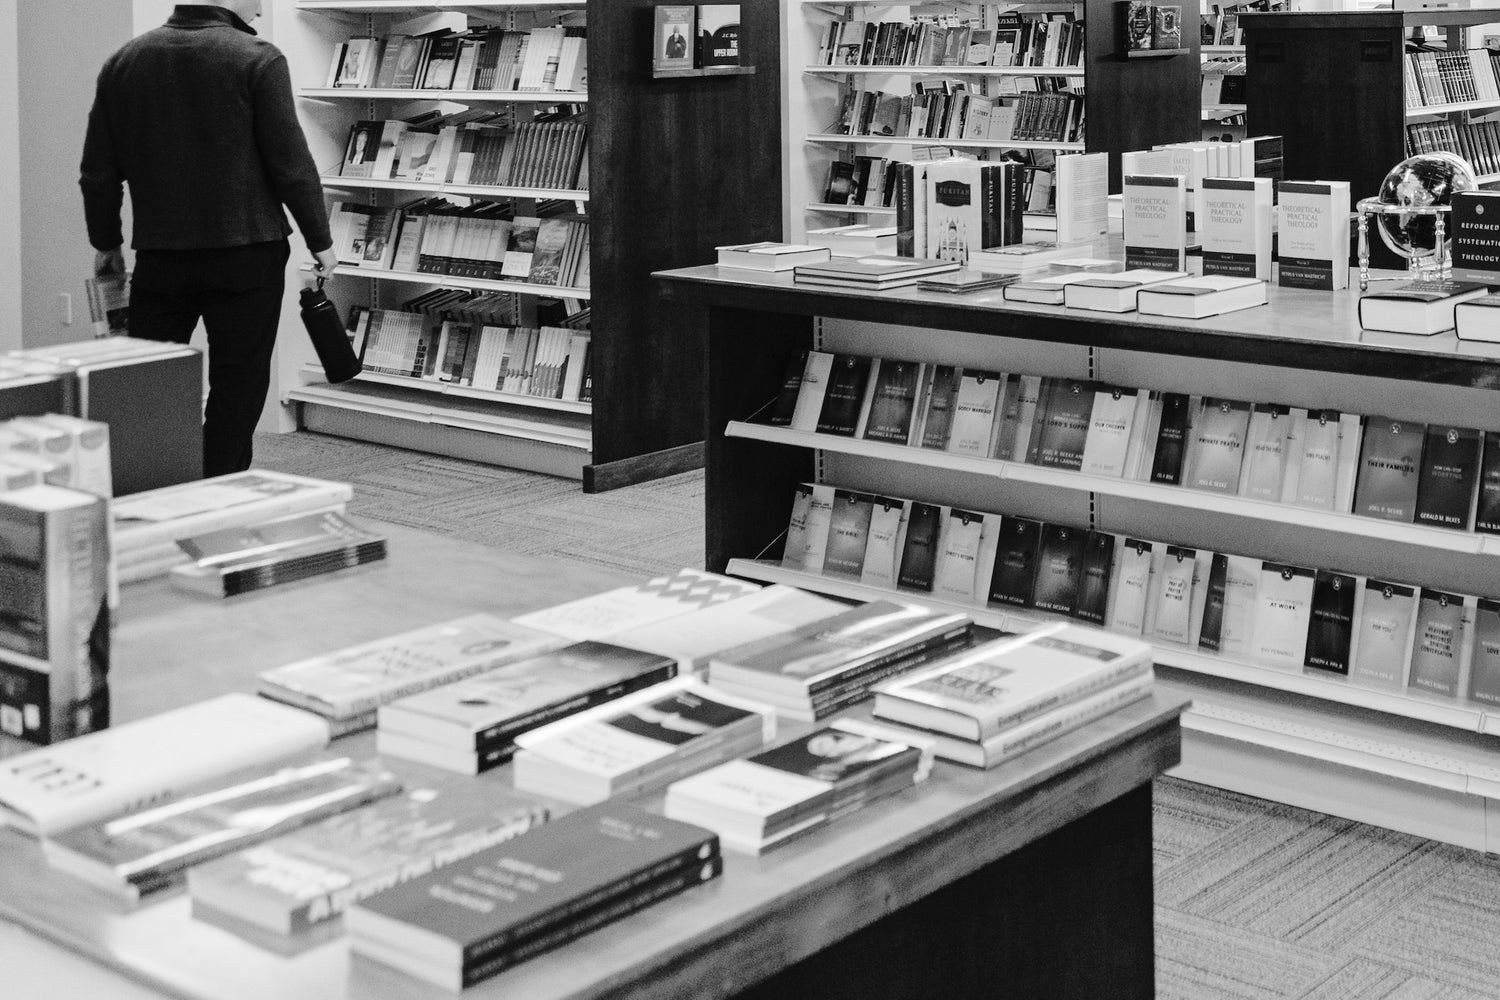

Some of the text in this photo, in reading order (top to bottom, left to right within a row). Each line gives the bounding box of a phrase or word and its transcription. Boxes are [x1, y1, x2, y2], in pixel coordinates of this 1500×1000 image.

[714, 49, 726, 57] UPPER
[939, 187, 970, 195] PURITAN
[1134, 204, 1166, 213] PRACTICAL
[1210, 208, 1243, 217] PRACTICAL
[1135, 211, 1167, 221] THEOLOGY
[1210, 215, 1243, 224] THEOLOGY
[1286, 213, 1318, 221] PRACTICAL
[1287, 219, 1319, 229] THEOLOGY
[1461, 222, 1500, 231] REFORMED
[1461, 254, 1500, 263] THEOLOGY
[1304, 272, 1326, 280] MASTRICHT
[1199, 438, 1240, 448] PRIVATE PRAYER
[1367, 461, 1414, 473] THEIR FAMILIES
[1432, 471, 1463, 479] WORRYING
[1387, 508, 1403, 516] BEEKE
[1420, 512, 1439, 521] GERALD
[1445, 515, 1461, 524] BILKES
[1278, 603, 1297, 611] WORK
[1421, 646, 1453, 658] CONVERSATION
[1486, 648, 1499, 656] LOVE
[1310, 657, 1338, 668] JOSEPH PIPA
